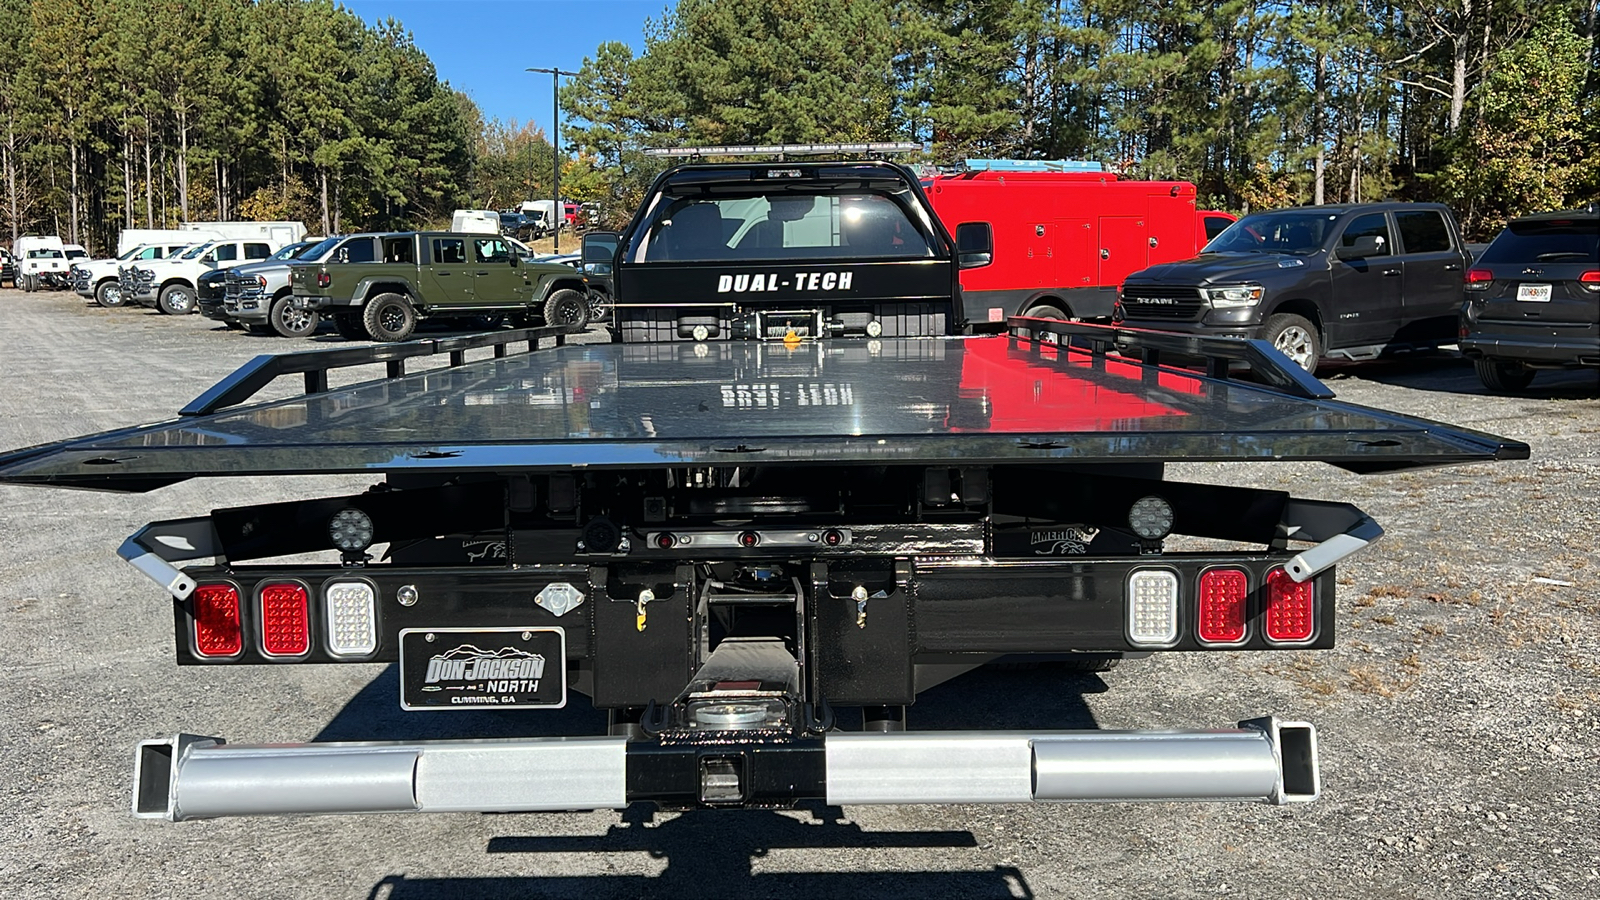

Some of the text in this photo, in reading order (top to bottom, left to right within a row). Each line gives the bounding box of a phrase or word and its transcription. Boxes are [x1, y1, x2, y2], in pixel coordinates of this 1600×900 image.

[717, 272, 853, 293] DUAL-TECH
[1139, 297, 1172, 305] RAM
[1031, 529, 1091, 545] AMERIC
[425, 657, 546, 684] DON JACKSON
[486, 680, 539, 693] NORTH
[451, 695, 516, 704] CUMMING, GA
